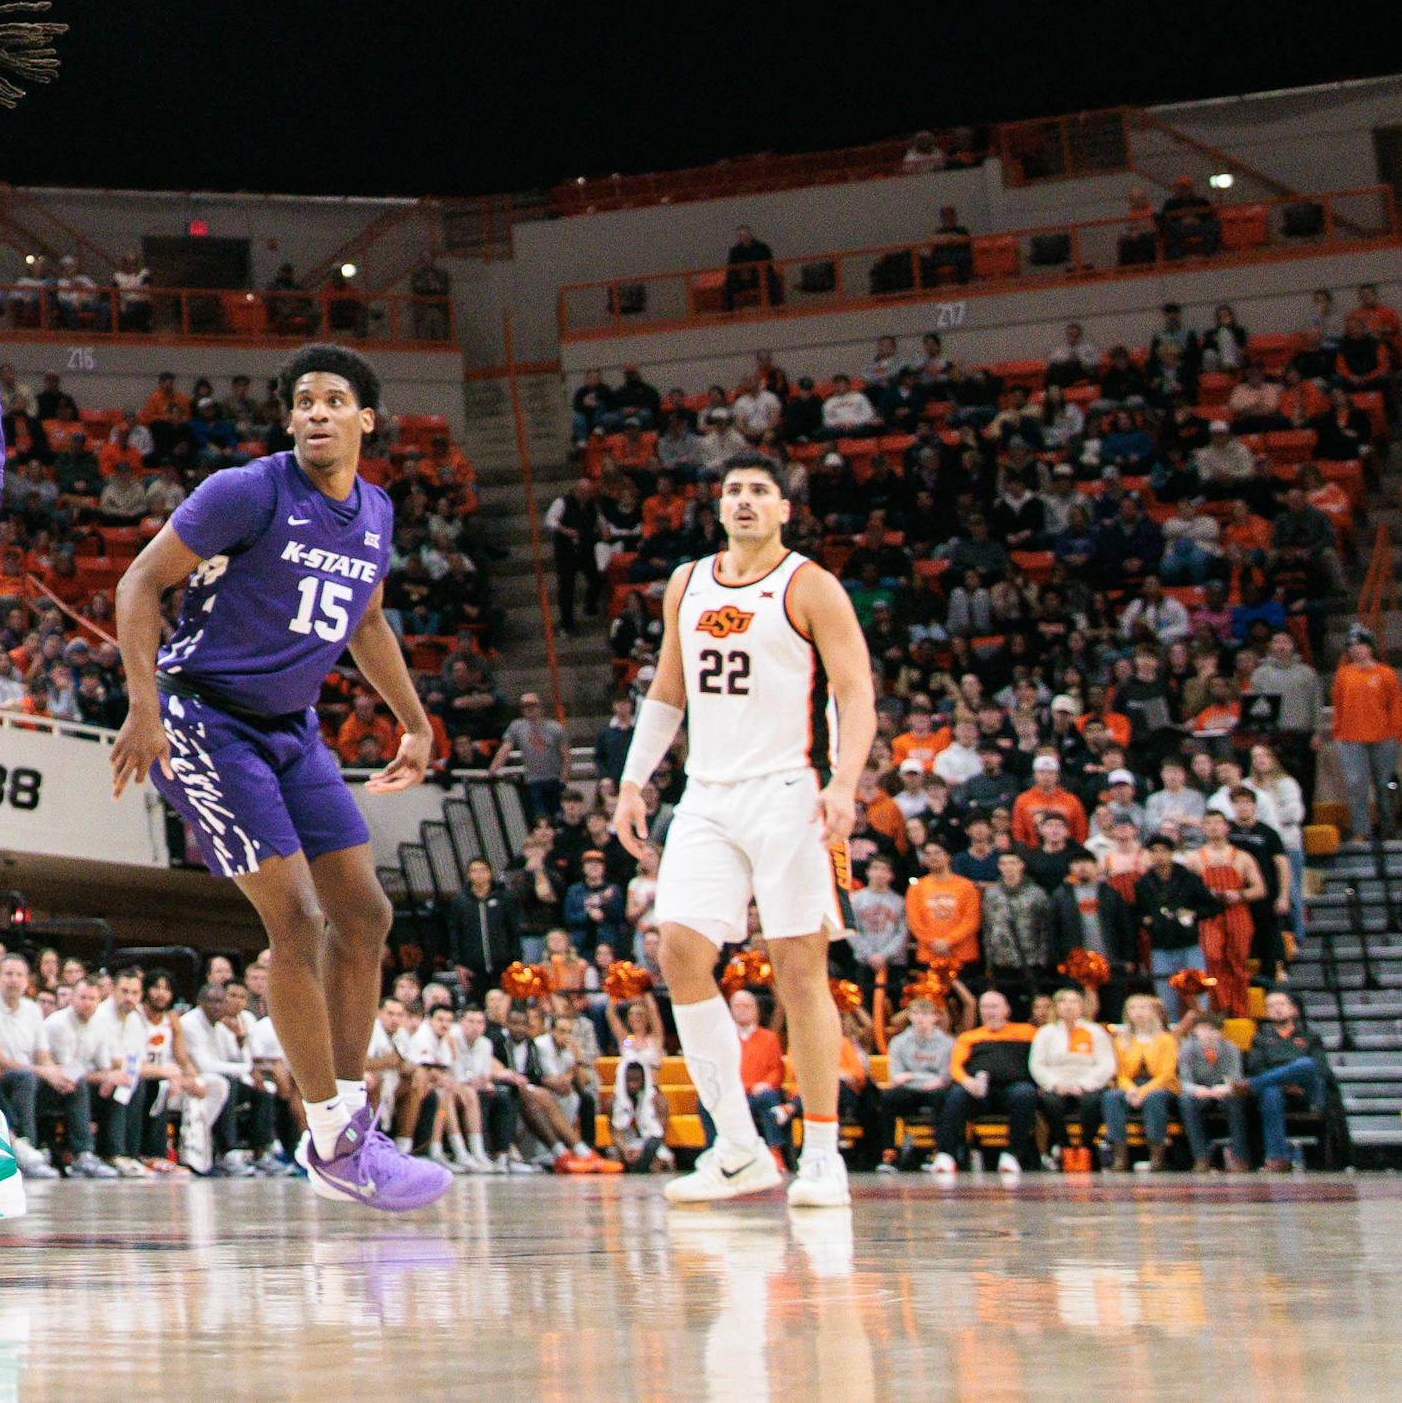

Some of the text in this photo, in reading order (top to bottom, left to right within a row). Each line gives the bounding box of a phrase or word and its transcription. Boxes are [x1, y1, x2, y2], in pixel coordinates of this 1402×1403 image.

[280, 540, 378, 584] K-STATE
[288, 575, 353, 643] 15
[695, 605, 756, 639] OSU
[699, 649, 751, 695] 22
